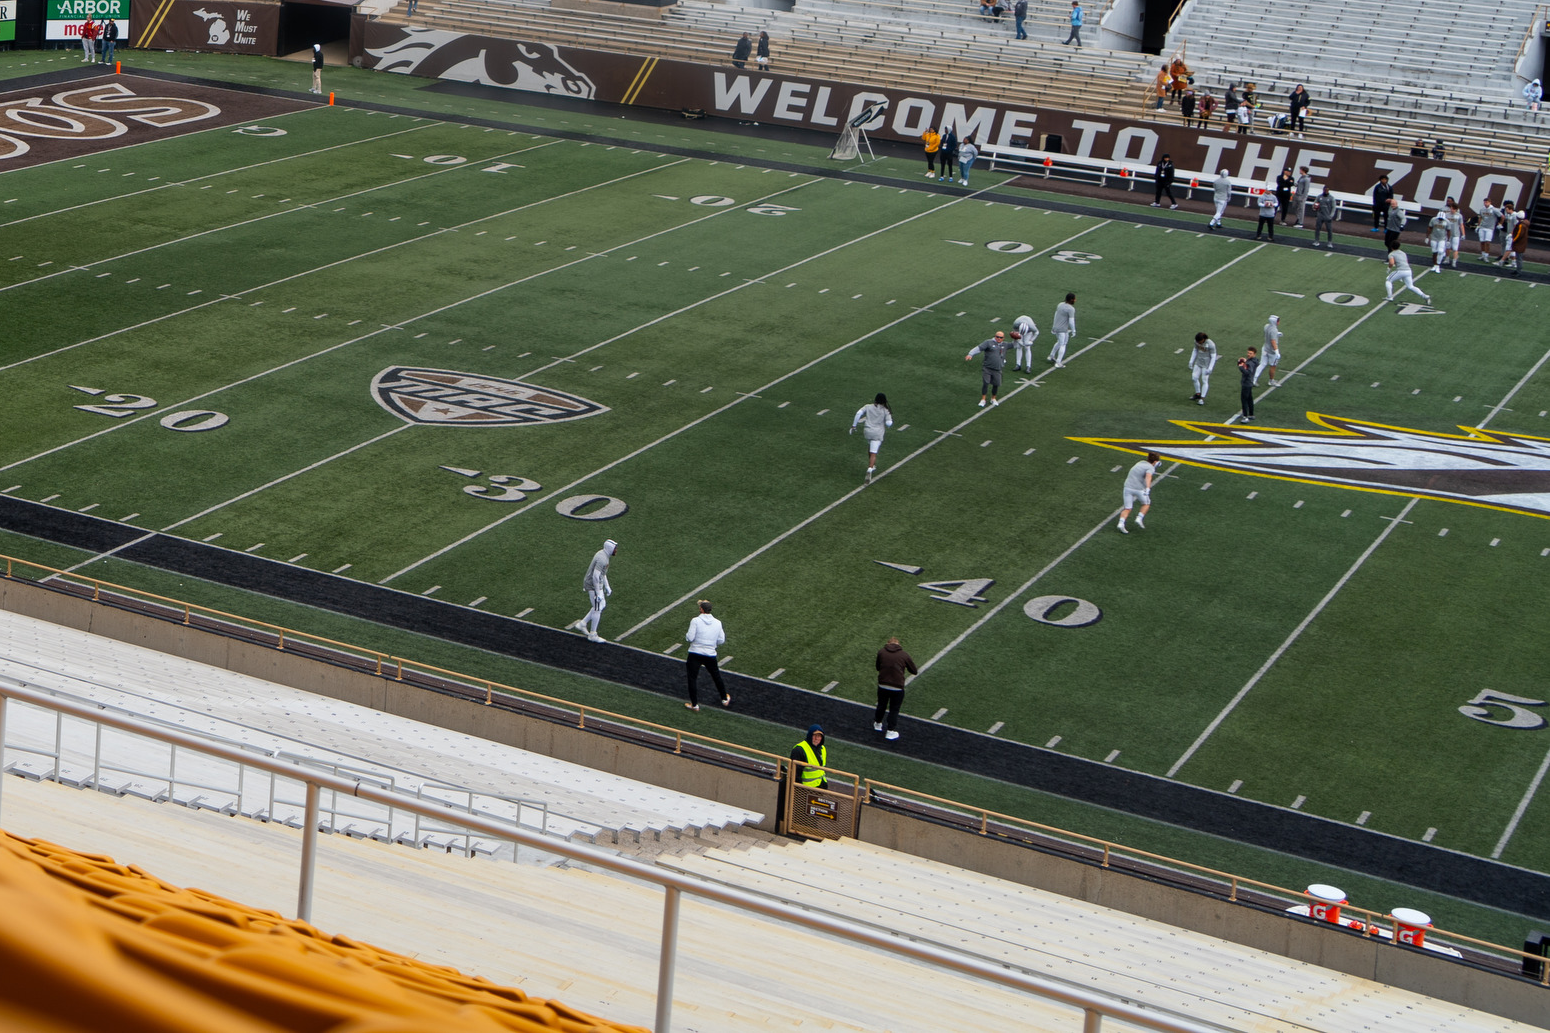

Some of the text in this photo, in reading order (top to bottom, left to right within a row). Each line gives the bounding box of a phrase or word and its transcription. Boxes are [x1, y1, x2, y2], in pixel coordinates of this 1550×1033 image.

[57, 0, 121, 14] ARBOR
[234, 21, 258, 33] MUST
[233, 33, 257, 45] UNITE
[714, 71, 1524, 217] WELCOME TO THE ZOO
[1458, 688, 1548, 730] 5
[1312, 905, 1327, 920] G
[1399, 930, 1414, 944] G
